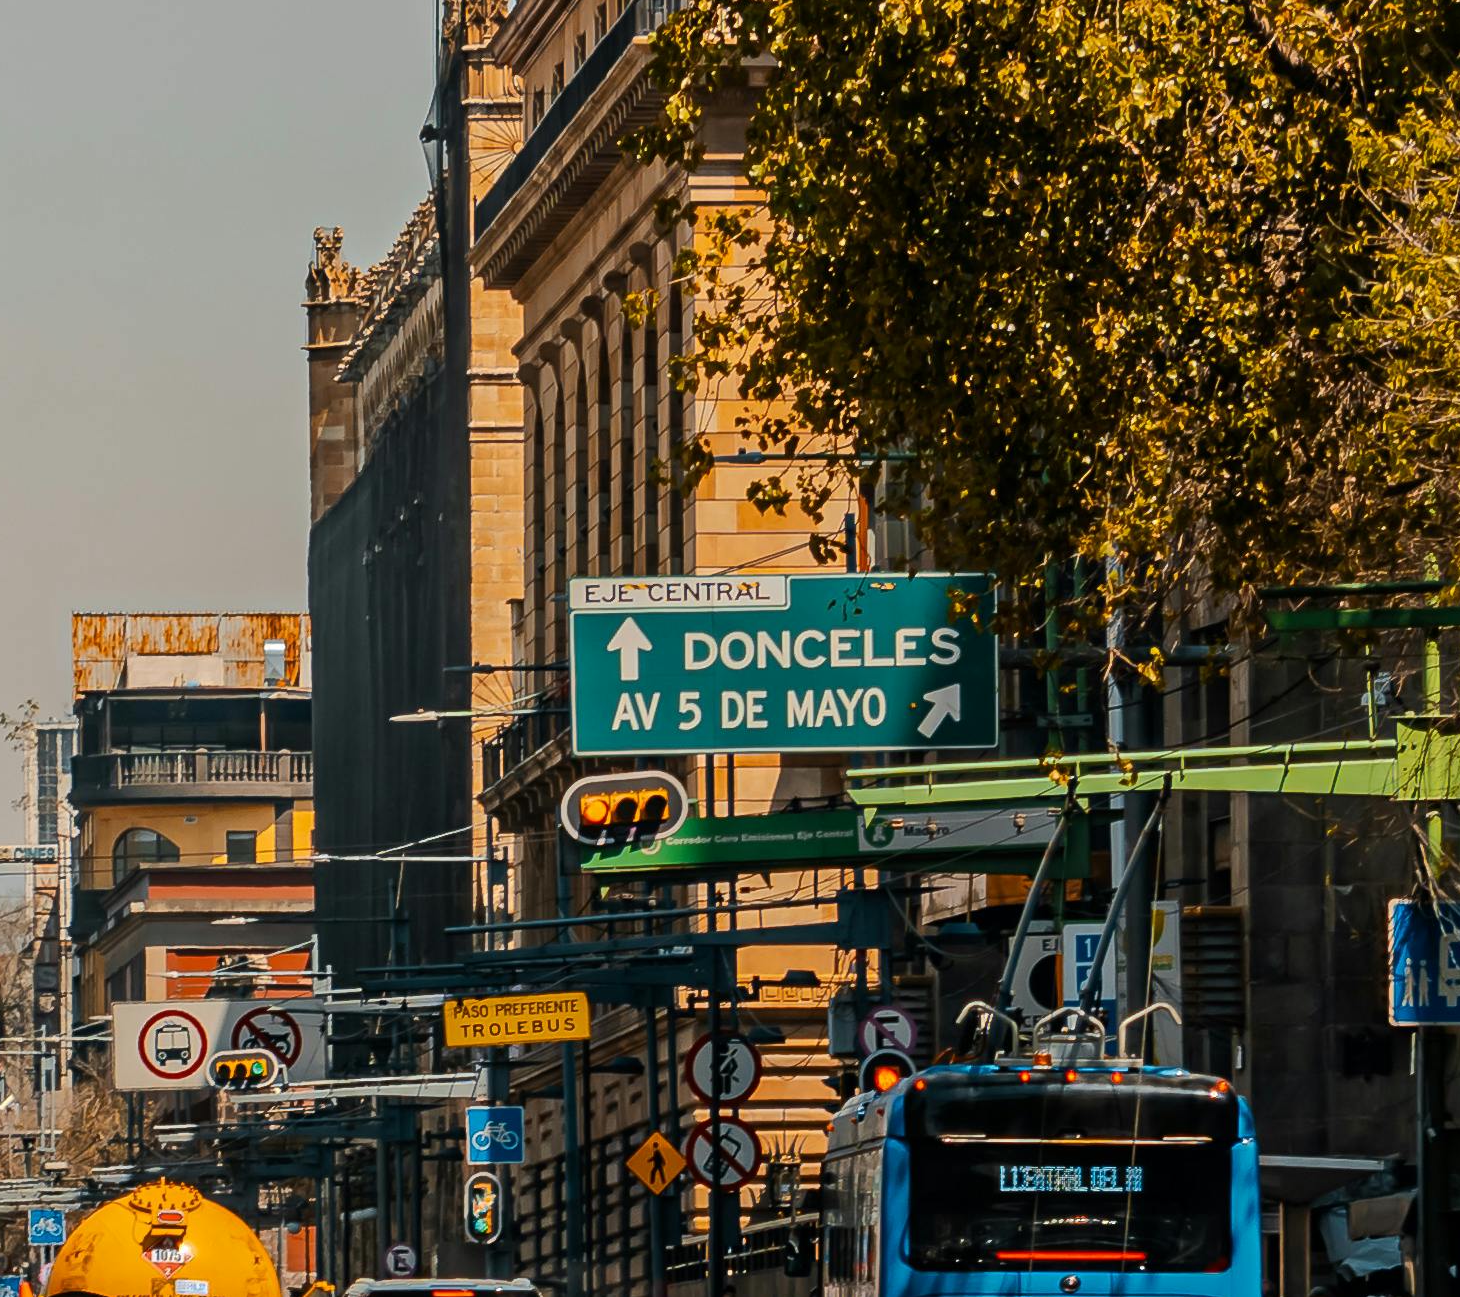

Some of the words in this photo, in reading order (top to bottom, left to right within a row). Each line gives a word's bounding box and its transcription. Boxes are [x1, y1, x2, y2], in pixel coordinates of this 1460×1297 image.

[585, 585, 634, 603] EJE
[648, 583, 770, 602] CENTRAL
[684, 627, 962, 671] DONCELES
[612, 692, 660, 731] AV
[679, 691, 701, 731] 5
[721, 690, 768, 729] DE
[787, 687, 886, 728] MAYO
[666, 833, 711, 847] Corredor
[741, 831, 794, 843] Emisiones
[816, 828, 854, 840] Central
[453, 1003, 489, 1020] PASO
[495, 998, 580, 1017] PREFERENTE
[461, 1018, 576, 1039] TROLEBUS
[155, 1249, 181, 1262] 1075
